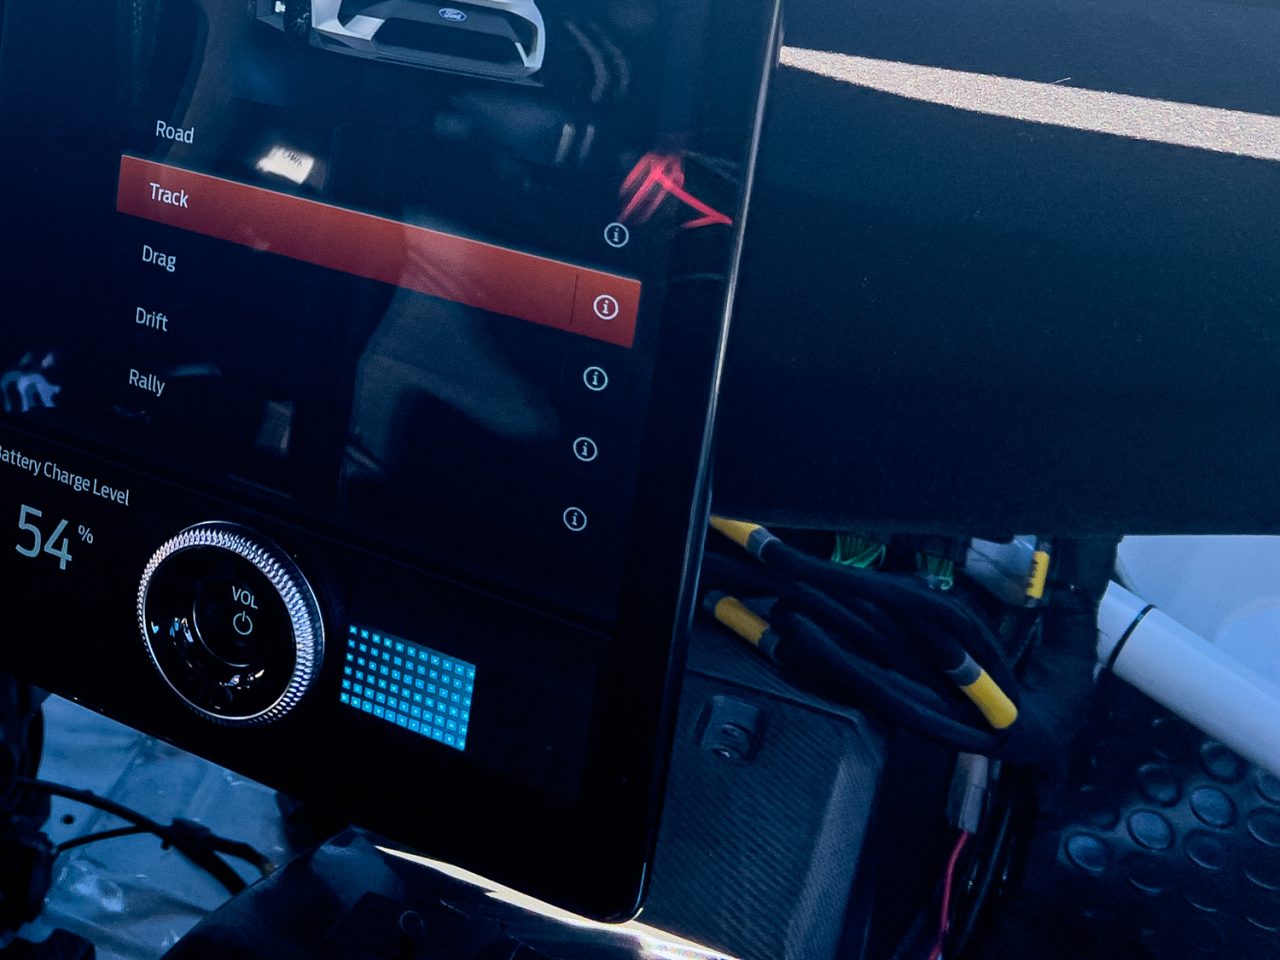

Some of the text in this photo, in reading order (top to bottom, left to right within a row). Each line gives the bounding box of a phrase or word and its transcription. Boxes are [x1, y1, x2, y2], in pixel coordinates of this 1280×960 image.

[155, 120, 195, 144] Road
[149, 182, 189, 209] Track
[141, 244, 176, 273] Drag
[135, 306, 168, 332] Drift
[128, 368, 165, 397] Rally
[43, 461, 90, 493] Charge
[93, 478, 130, 507] Level
[231, 585, 259, 611] VOL
